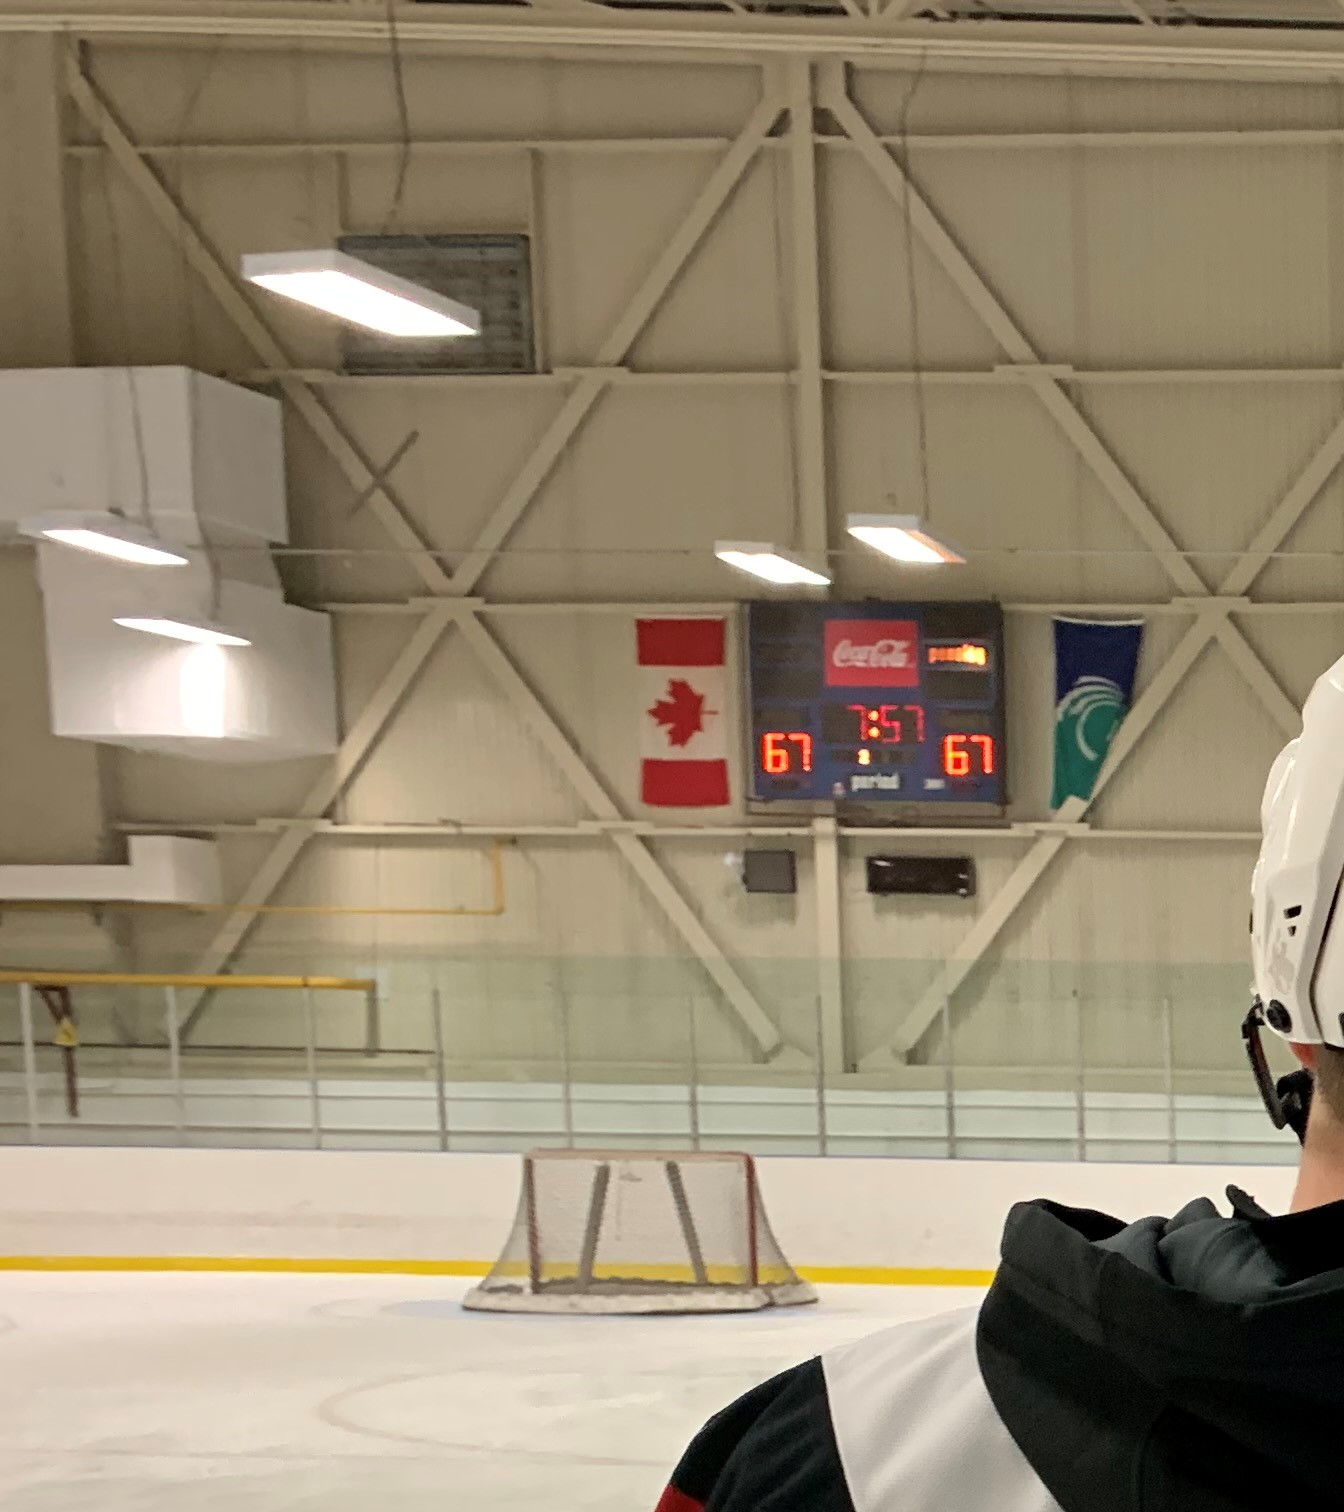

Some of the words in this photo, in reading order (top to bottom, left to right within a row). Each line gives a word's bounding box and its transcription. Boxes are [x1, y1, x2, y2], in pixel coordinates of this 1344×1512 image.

[848, 704, 926, 743] 7:57
[762, 731, 812, 774] 67
[942, 734, 994, 776] 67
